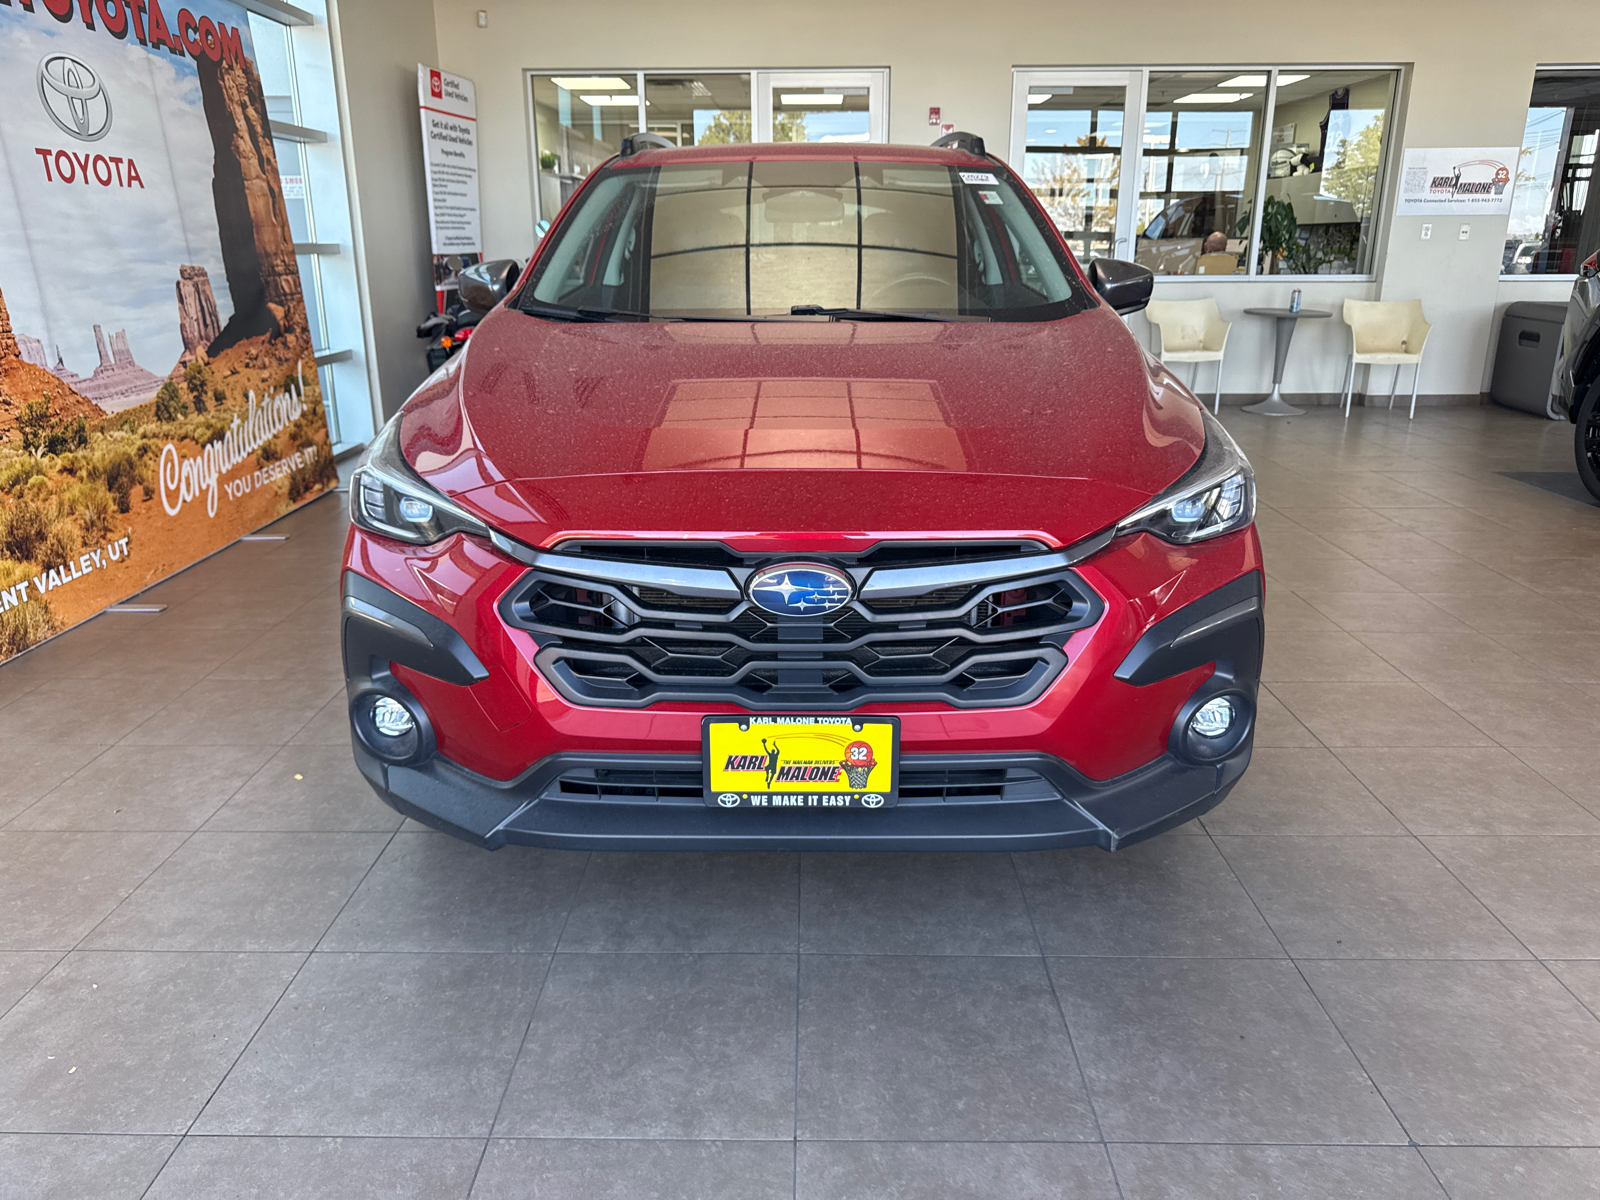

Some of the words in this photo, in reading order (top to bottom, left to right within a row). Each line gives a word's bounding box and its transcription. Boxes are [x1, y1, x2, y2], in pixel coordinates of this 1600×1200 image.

[443, 78, 460, 90] Certified
[458, 124, 471, 135] Toyota
[430, 130, 449, 142] Certified
[34, 147, 145, 189] TOYOTA
[1497, 170, 1507, 179] 32
[1429, 176, 1454, 188] KARL
[1456, 182, 1493, 194] MALONE
[160, 359, 308, 518] Congratulations!
[224, 474, 251, 500] YOU
[253, 450, 304, 489] DESERVE
[304, 445, 318, 466] IT!
[32, 548, 107, 595] VALLEY,
[107, 536, 129, 561] UT
[749, 717, 775, 725] KARL
[776, 717, 815, 725] MALONE
[816, 717, 852, 725] TOYOTA
[851, 747, 867, 760] 32
[724, 755, 767, 771] KARL
[776, 765, 841, 782] MALONE
[751, 796, 768, 806] WE
[772, 796, 804, 806] MAKE
[808, 796, 818, 806] IT
[823, 796, 851, 806] EASY
